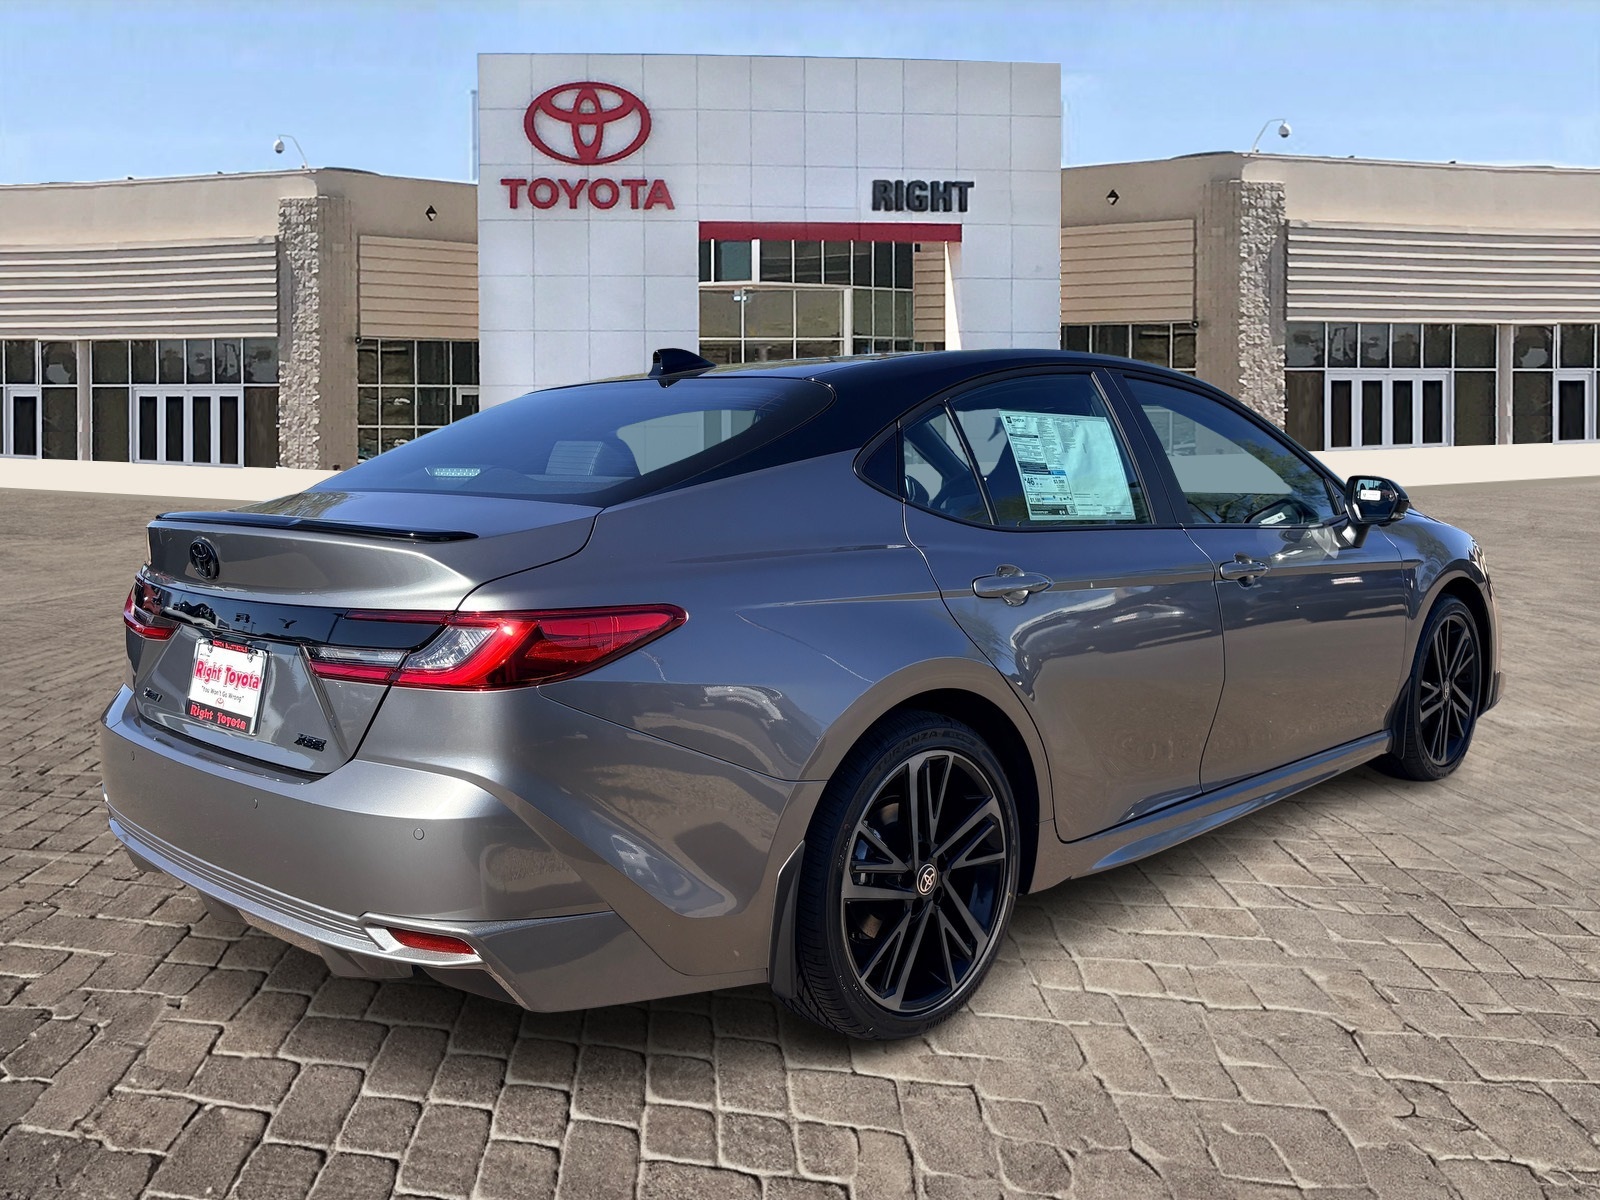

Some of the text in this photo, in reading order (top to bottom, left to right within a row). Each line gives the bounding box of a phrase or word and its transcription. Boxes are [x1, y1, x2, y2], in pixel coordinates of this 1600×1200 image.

[501, 178, 675, 211] TOYOTA
[872, 179, 975, 212] RIGHT
[195, 659, 260, 690] Right Toyota
[190, 704, 247, 730] Right Toyota
